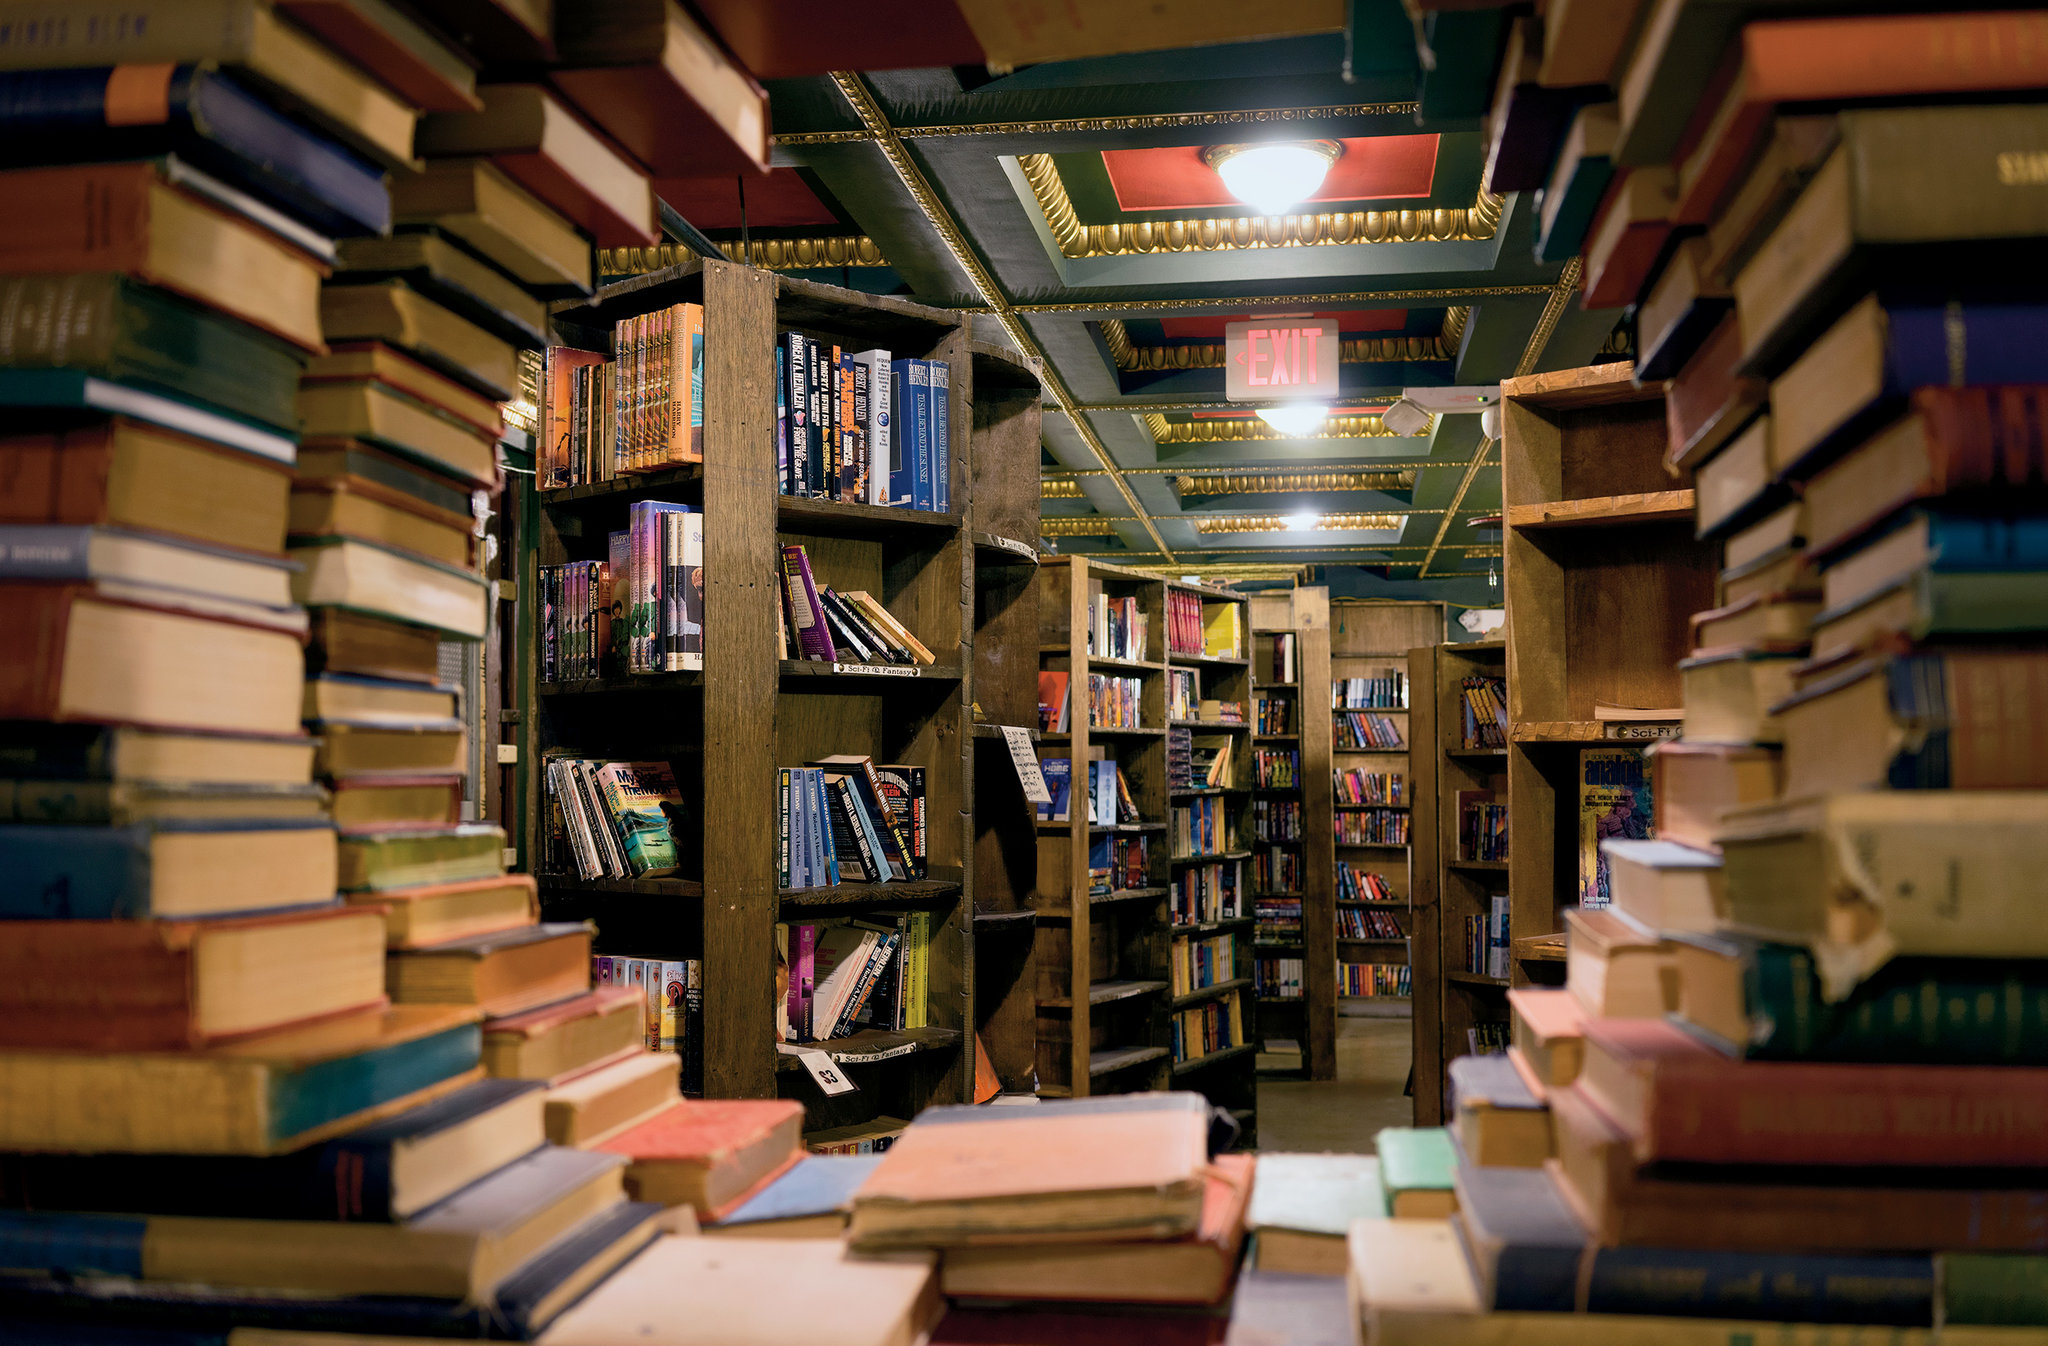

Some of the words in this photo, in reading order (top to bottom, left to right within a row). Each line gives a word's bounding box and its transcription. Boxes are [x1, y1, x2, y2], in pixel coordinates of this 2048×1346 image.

[792, 334, 804, 364] ROBERT
[1248, 328, 1322, 386] EXIT
[855, 366, 867, 388] ROBERT
[908, 364, 925, 376] ROBERT
[930, 366, 948, 378] ROBERT
[793, 372, 805, 409] HEINLEIN
[918, 394, 925, 404] TO
[939, 395, 946, 406] TO
[856, 395, 867, 422] HEINLEIN
[918, 404, 926, 418] SAIL
[919, 418, 927, 444] BEYOND
[939, 420, 947, 446] BEYOND
[920, 458, 928, 483] SUNSET
[611, 537, 630, 546] HARRY
[883, 667, 912, 675] Fantasy
[1632, 728, 1670, 737] Sci-Fi
[615, 770, 635, 785] My
[1585, 755, 1643, 787] analog
[607, 781, 616, 792] My
[620, 785, 642, 796] The
[641, 785, 672, 796] Moon
[865, 761, 877, 784] ROBERT
[876, 787, 890, 814] HEINLEIN
[885, 772, 909, 800] UNIVERSE
[604, 786, 612, 799] The
[608, 797, 618, 812] Moon
[611, 790, 622, 807] Sister
[842, 793, 853, 812] ROBERT
[850, 815, 863, 838] HEINLEIN
[893, 828, 905, 850] GLORY
[902, 850, 913, 868] ROAD
[872, 946, 893, 977] HEINLEIN
[857, 968, 872, 989] Robert
[869, 977, 877, 986] THE
[854, 987, 861, 996] A.
[859, 985, 872, 1004] ROLLING
[841, 994, 858, 1020] Heinlein
[850, 1003, 862, 1021] STONES
[881, 1047, 908, 1058] Fantasy
